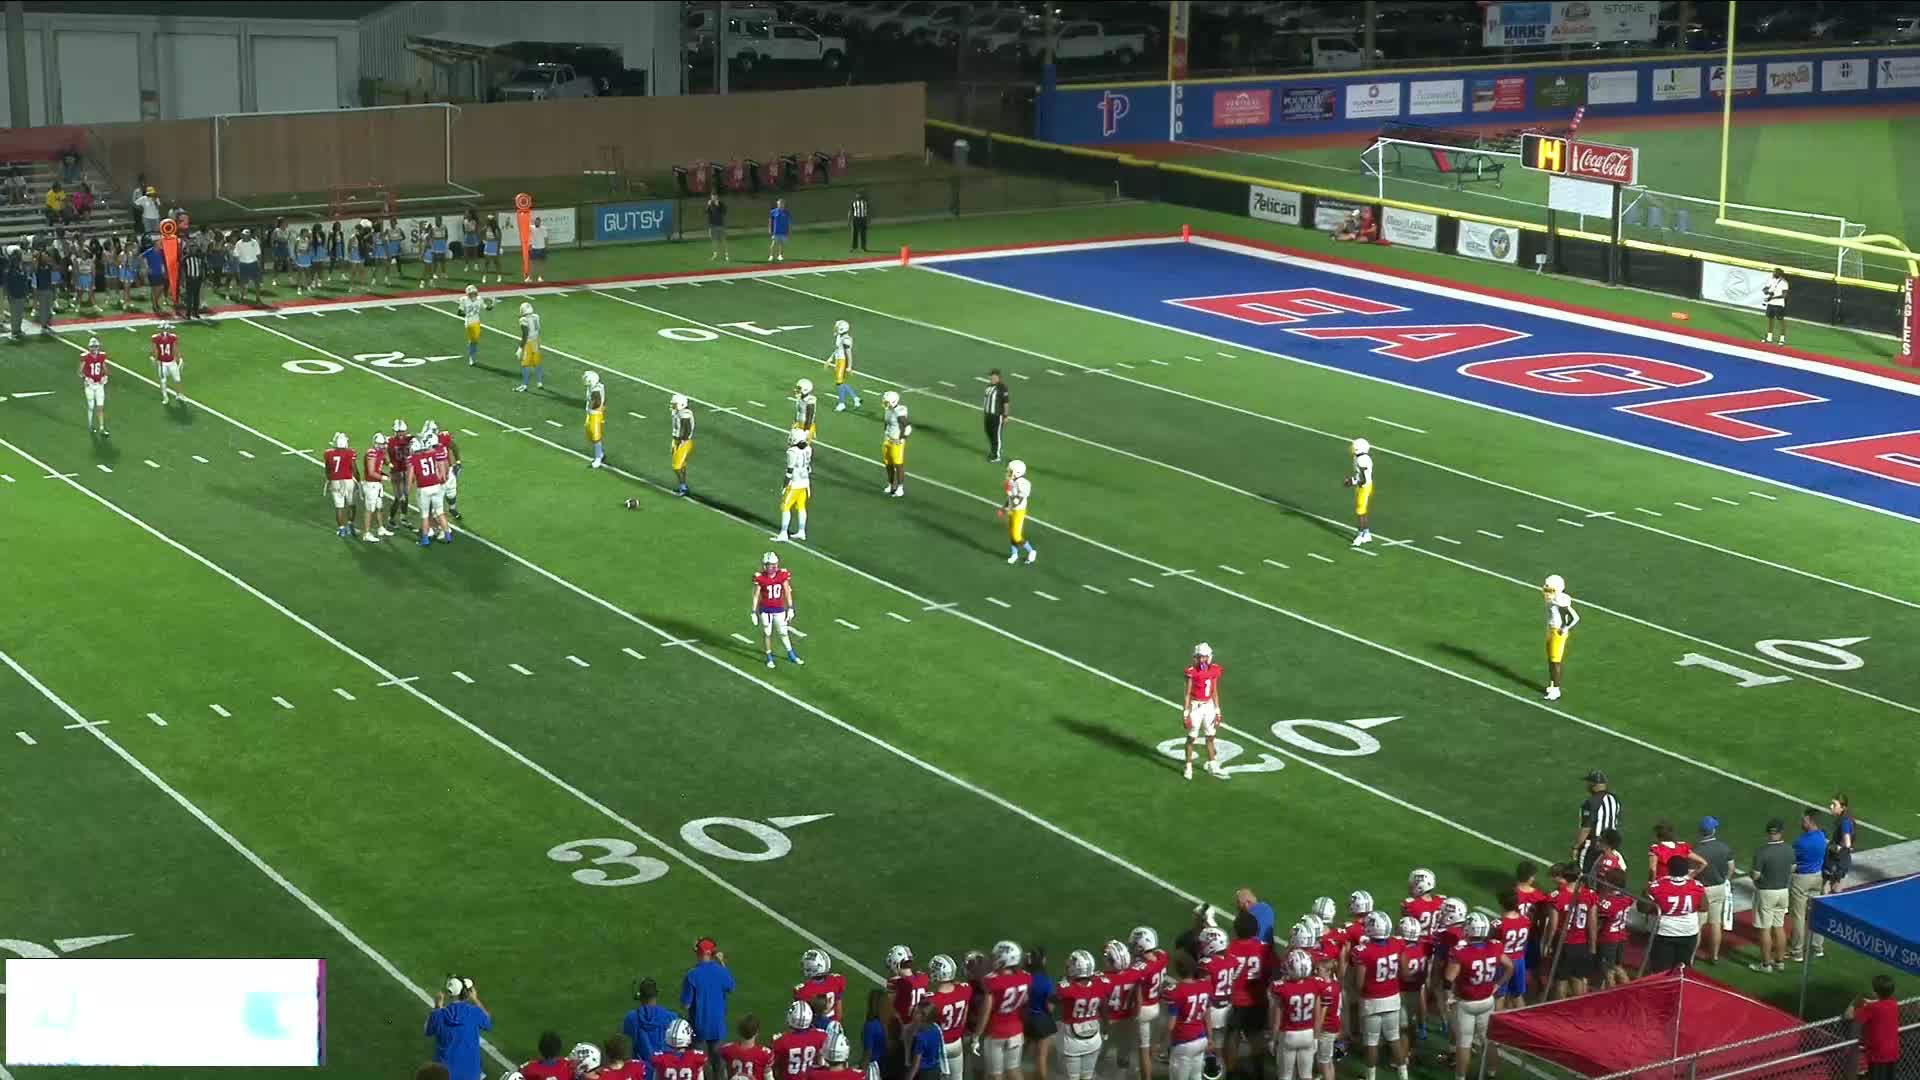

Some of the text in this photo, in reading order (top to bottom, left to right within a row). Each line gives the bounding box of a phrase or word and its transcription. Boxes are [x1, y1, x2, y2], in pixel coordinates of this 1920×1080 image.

[1504, 24, 1546, 39] KIRKS
[1175, 86, 1183, 134] 300
[1254, 192, 1296, 217] Pelican
[604, 210, 664, 232] GUTSY
[1902, 278, 1913, 356] EAGLES
[160, 343, 170, 355] 14
[90, 362, 101, 375] 16
[333, 456, 341, 472] 7
[420, 457, 436, 476] 51
[767, 584, 782, 599] 10
[1204, 678, 1212, 697] 1
[546, 816, 792, 886] 30
[1504, 928, 1528, 953] 22
[1827, 919, 1899, 959] PARKVIEW
[1376, 953, 1398, 982] 65
[1471, 956, 1496, 984] 35
[1001, 984, 1028, 1013] 27
[1289, 993, 1315, 1022] 32
[942, 1000, 966, 1030] 37
